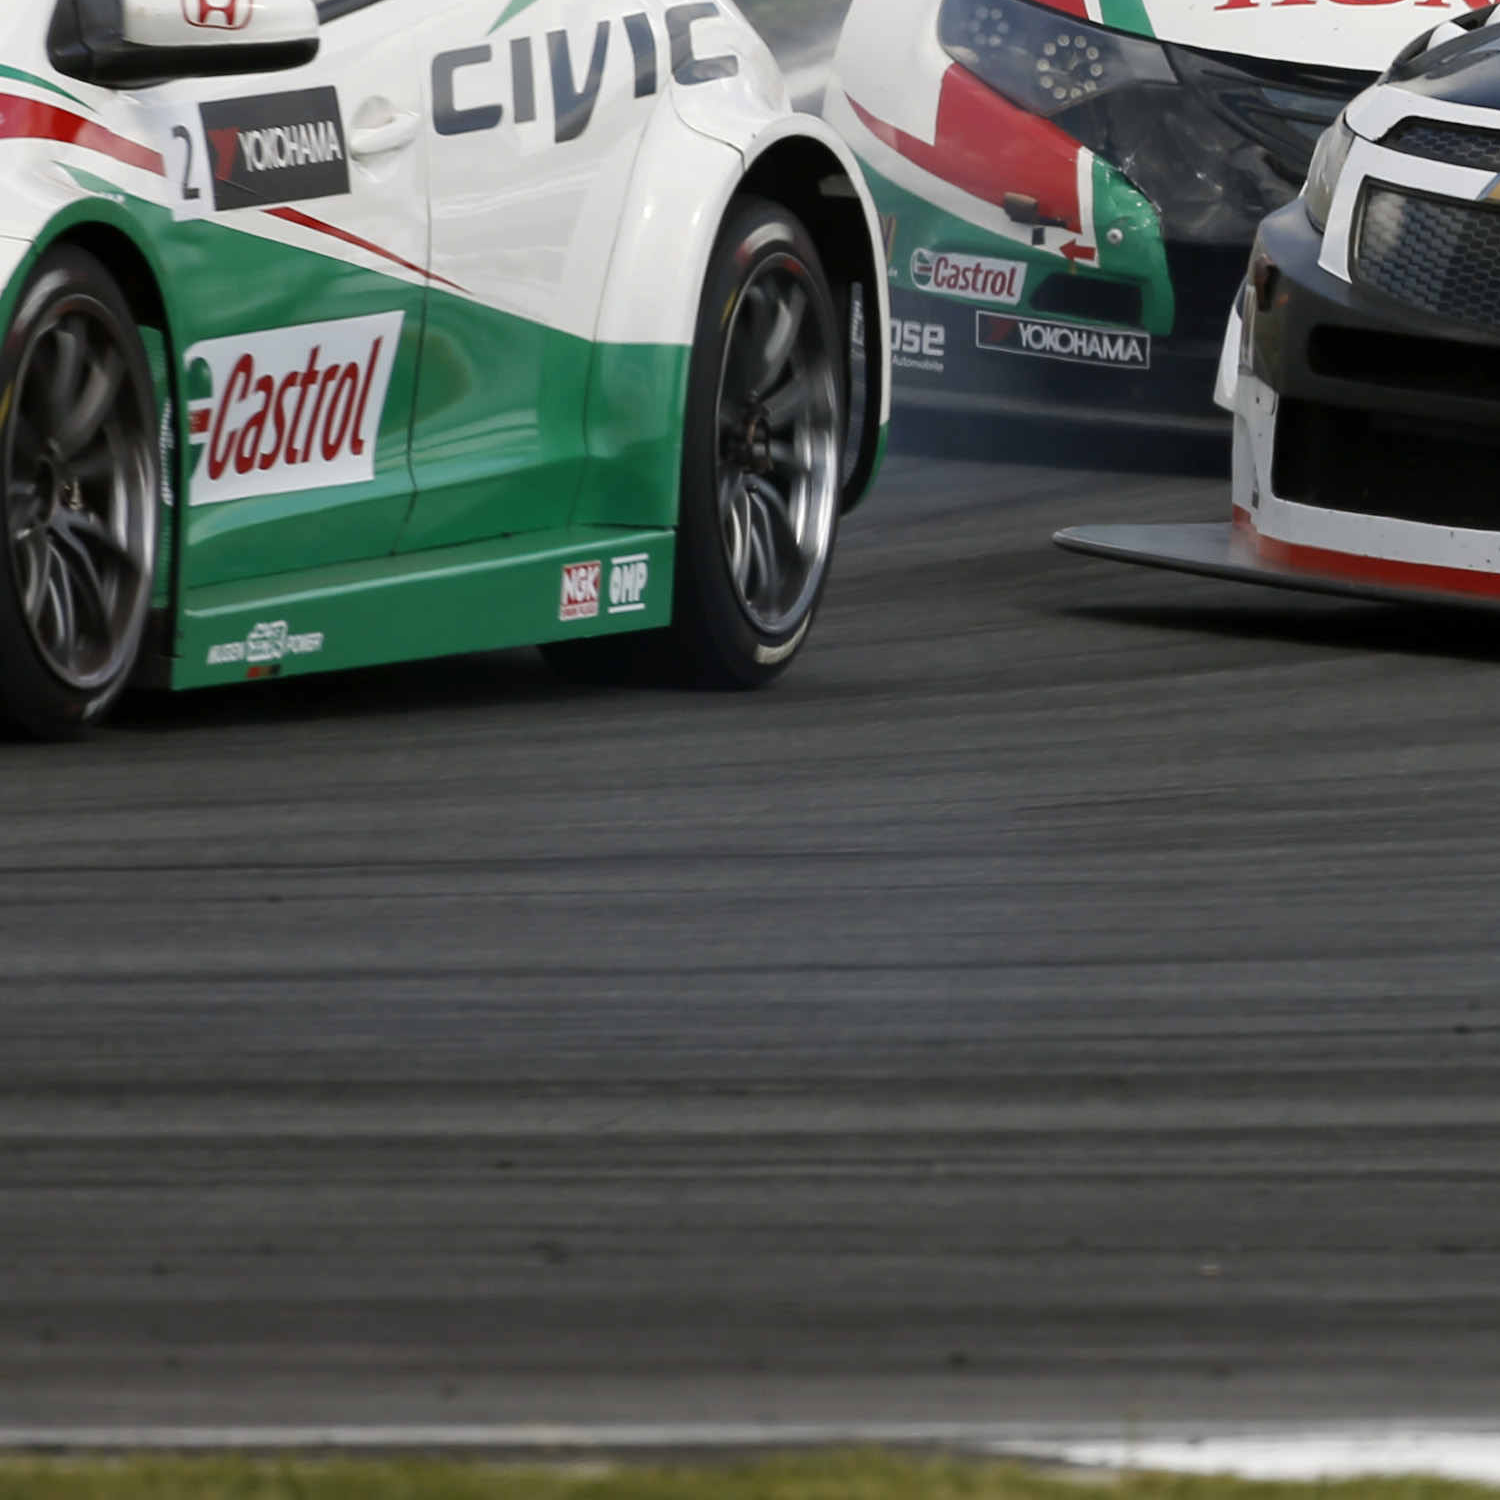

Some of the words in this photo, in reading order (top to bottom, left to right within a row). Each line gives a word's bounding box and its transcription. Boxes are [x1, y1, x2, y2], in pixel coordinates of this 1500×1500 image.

[430, 2, 740, 144] CIVIC
[171, 124, 201, 200] 2
[238, 117, 343, 176] YOKOHAMA
[931, 255, 1018, 298] Castrol
[1017, 320, 1144, 363] YOKOHAMA
[208, 334, 384, 481] Castrol
[561, 564, 599, 606] NGK
